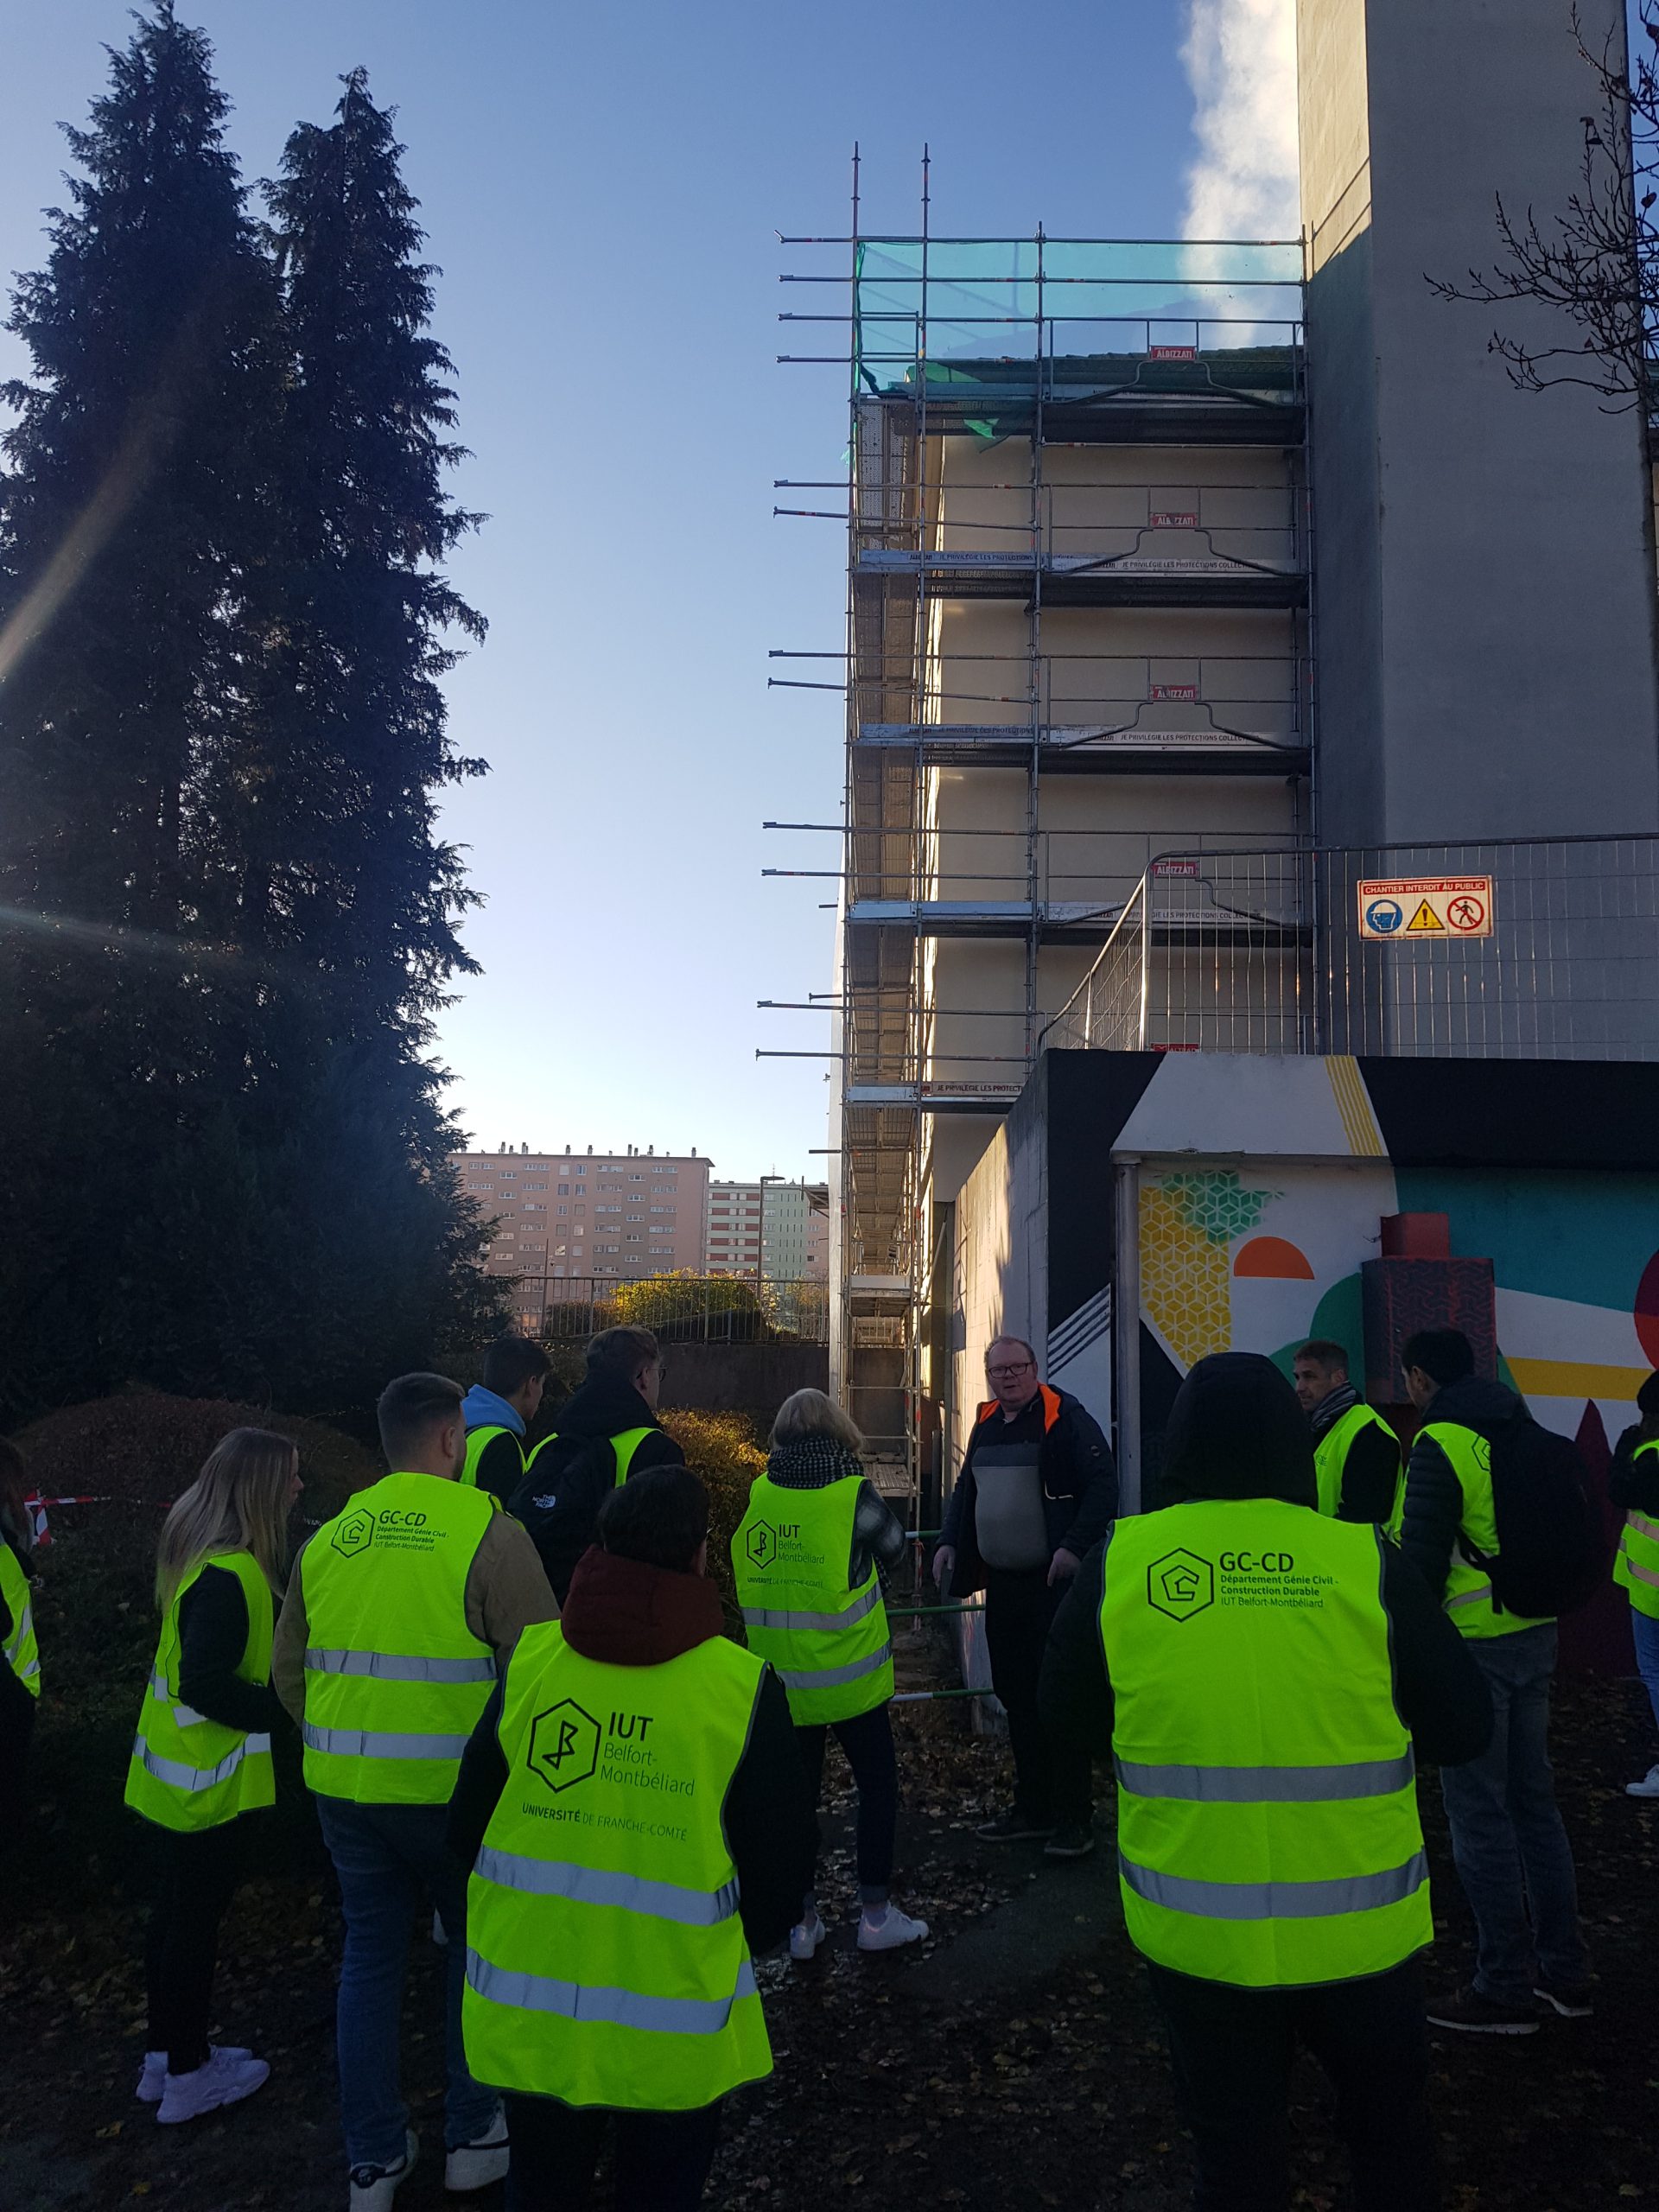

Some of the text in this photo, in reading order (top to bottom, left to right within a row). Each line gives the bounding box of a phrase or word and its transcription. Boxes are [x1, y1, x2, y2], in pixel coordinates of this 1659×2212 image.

[1365, 885, 1404, 894] CHANTIER
[379, 1510, 427, 1527] GC-CD
[377, 1525, 414, 1535] Département
[432, 1529, 447, 1538] Civil
[779, 1523, 801, 1538] IUT
[375, 1534, 435, 1544] Construction Durable
[779, 1540, 805, 1551] Belfort-
[779, 1552, 825, 1565] Montbéliard
[1219, 1551, 1294, 1573] GC-CD
[1220, 1574, 1281, 1585] Département
[1284, 1575, 1311, 1585] Génie
[1313, 1575, 1333, 1585] Civil
[1221, 1586, 1320, 1597] Construction Durable
[1221, 1597, 1324, 1608] IUT Belfort-Montbéliard
[608, 1712, 654, 1742] IUT
[604, 1742, 658, 1766] Belfort-
[601, 1764, 695, 1797] Montbéliard
[522, 1802, 687, 1841] UNIVERSITÉ DE FRANCHE-COMTÉ
